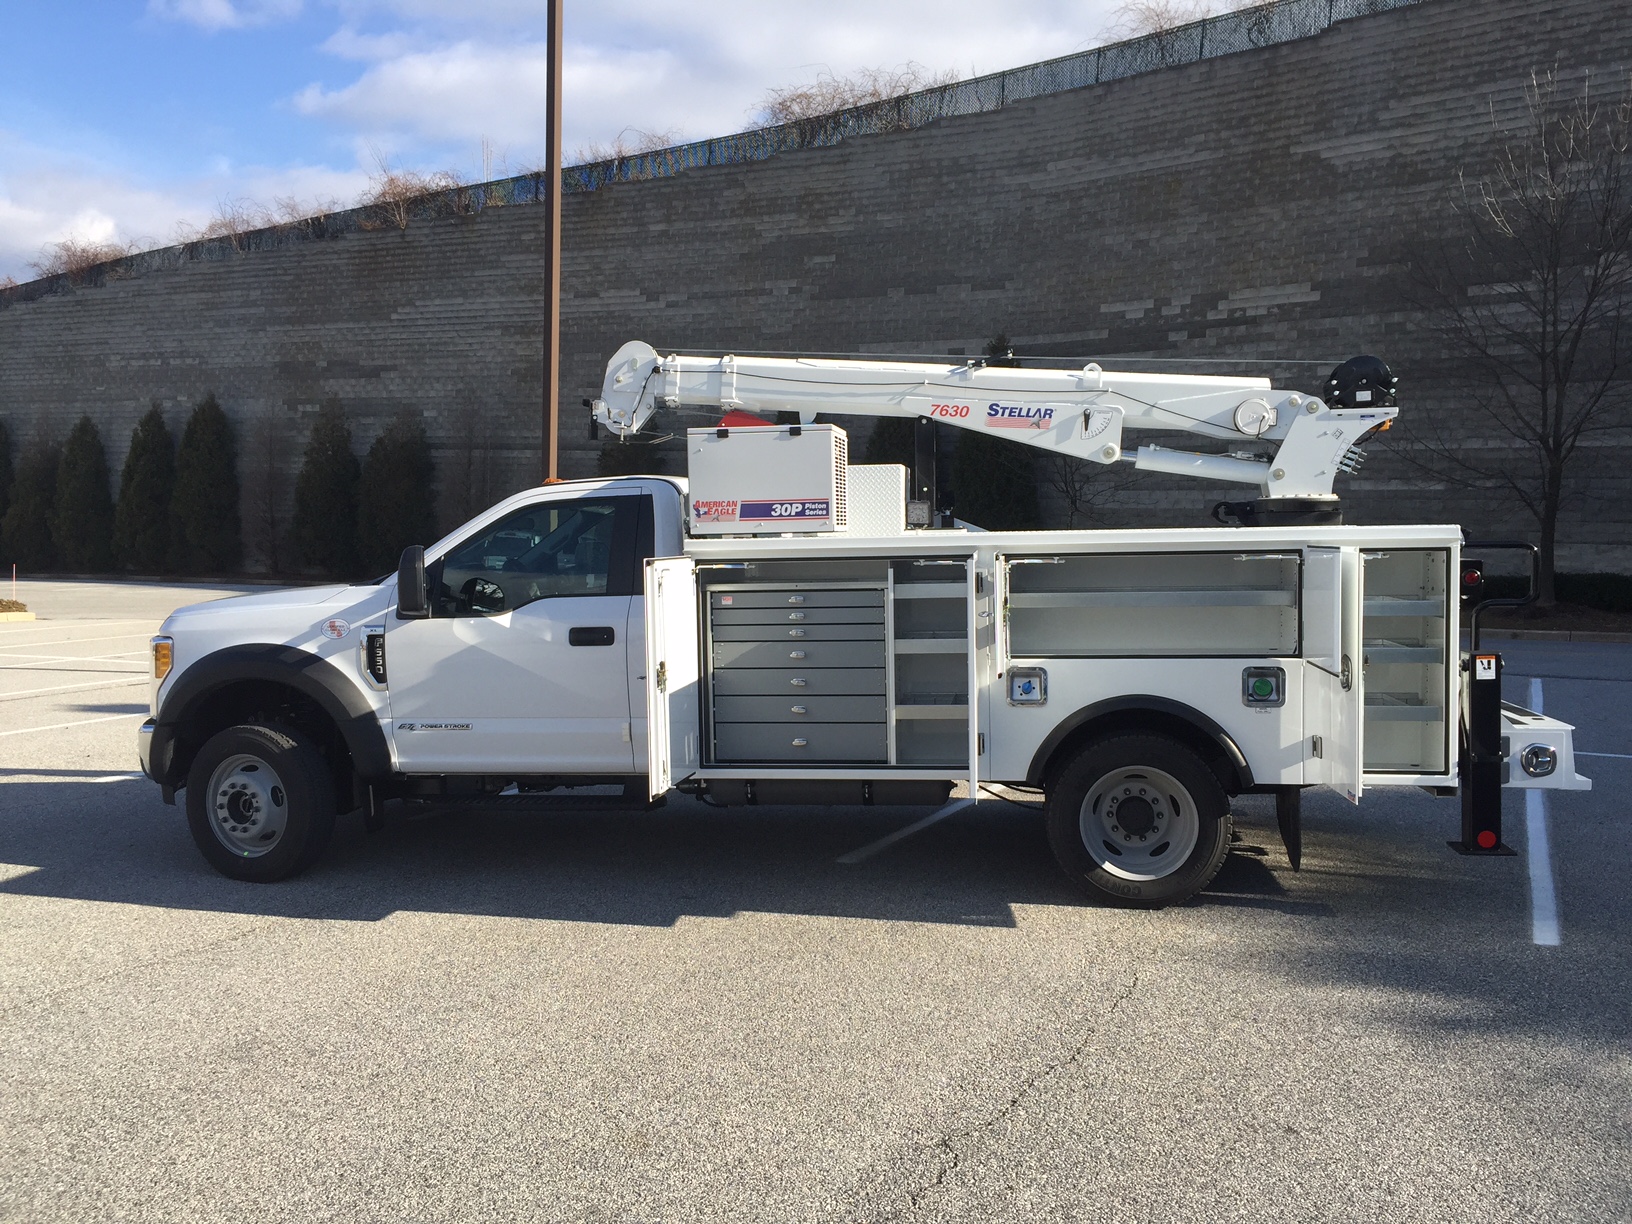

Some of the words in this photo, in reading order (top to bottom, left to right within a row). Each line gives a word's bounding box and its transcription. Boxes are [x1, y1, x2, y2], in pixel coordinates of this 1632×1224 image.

[929, 404, 970, 418] 7630
[987, 403, 1054, 419] STELLAR
[694, 500, 738, 508] AMERICAN
[771, 503, 802, 517] 30P
[706, 507, 737, 516] EAGLE
